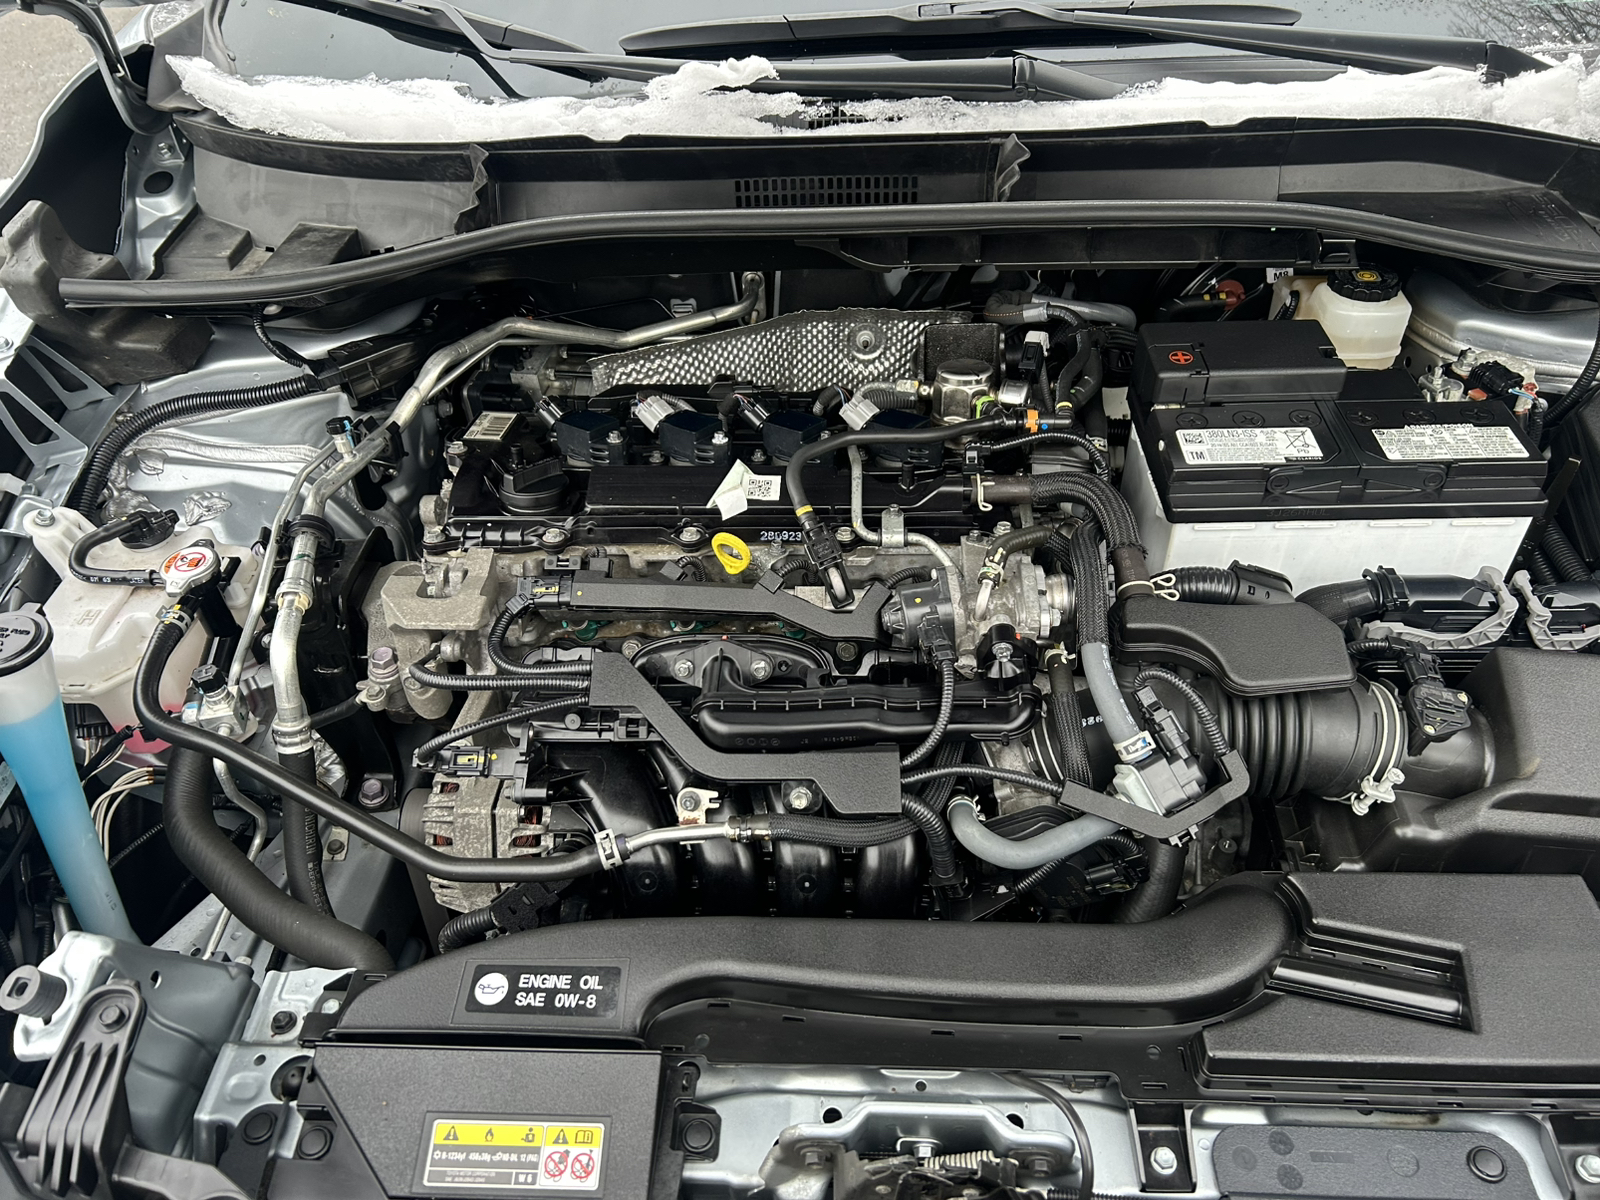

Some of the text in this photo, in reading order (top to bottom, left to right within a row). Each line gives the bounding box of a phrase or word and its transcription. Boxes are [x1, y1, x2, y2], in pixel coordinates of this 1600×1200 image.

[1189, 451, 1206, 461] TM
[518, 974, 604, 990] ENGINE OIL
[514, 992, 597, 1009] SAE 0W-8
[518, 1173, 533, 1184] W 6
